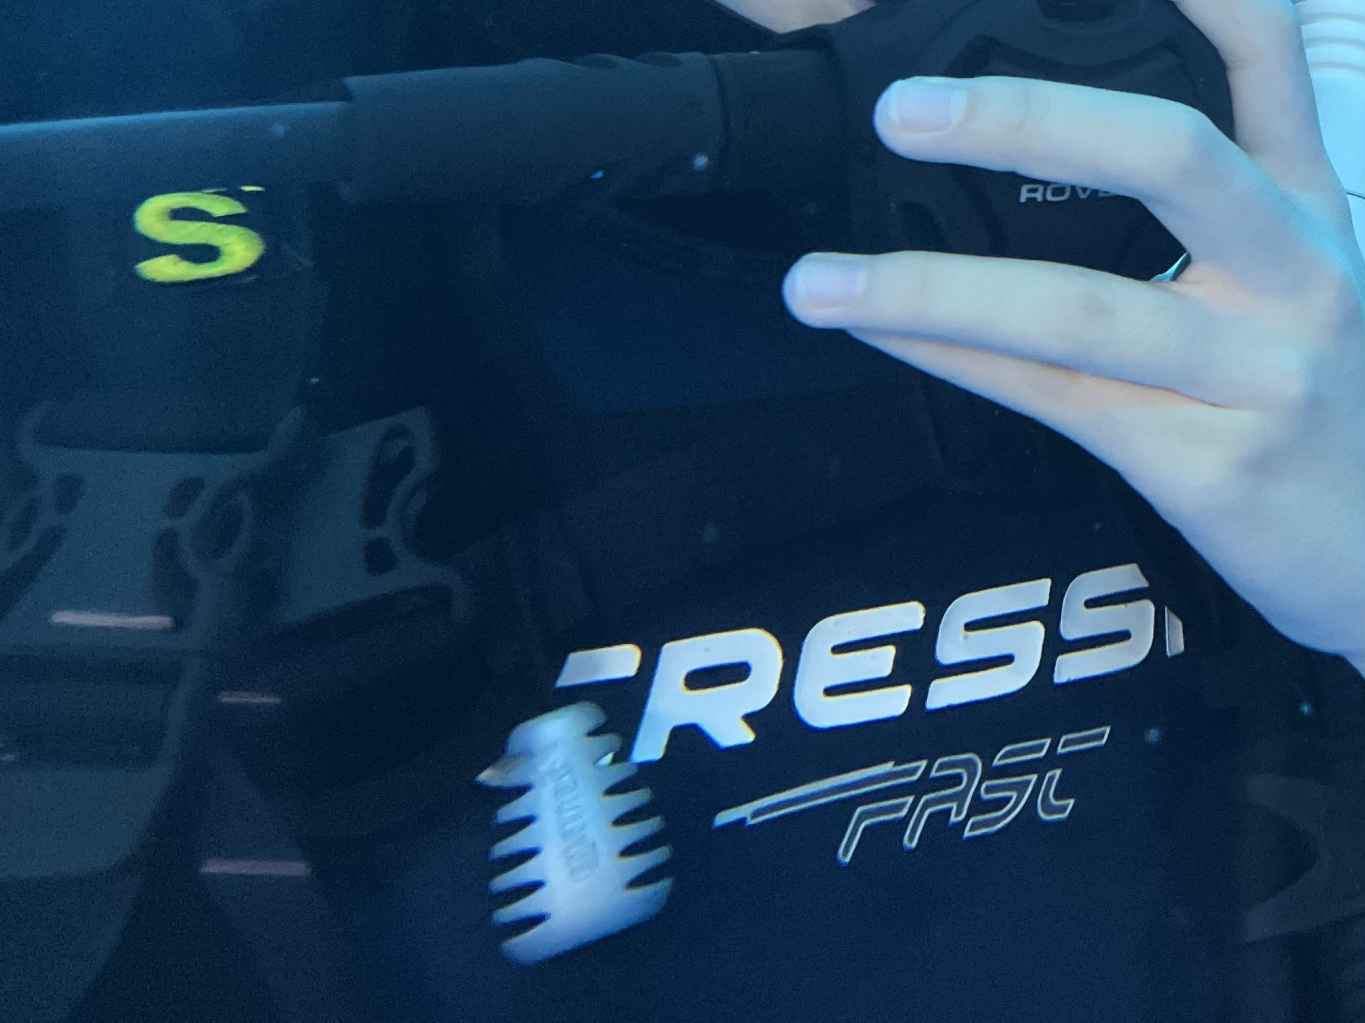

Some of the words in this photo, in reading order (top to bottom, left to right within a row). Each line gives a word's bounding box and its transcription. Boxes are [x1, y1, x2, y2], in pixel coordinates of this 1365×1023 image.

[1019, 184, 1118, 203] ROV
[554, 563, 1185, 763] RESS
[714, 727, 1110, 864] FAST
